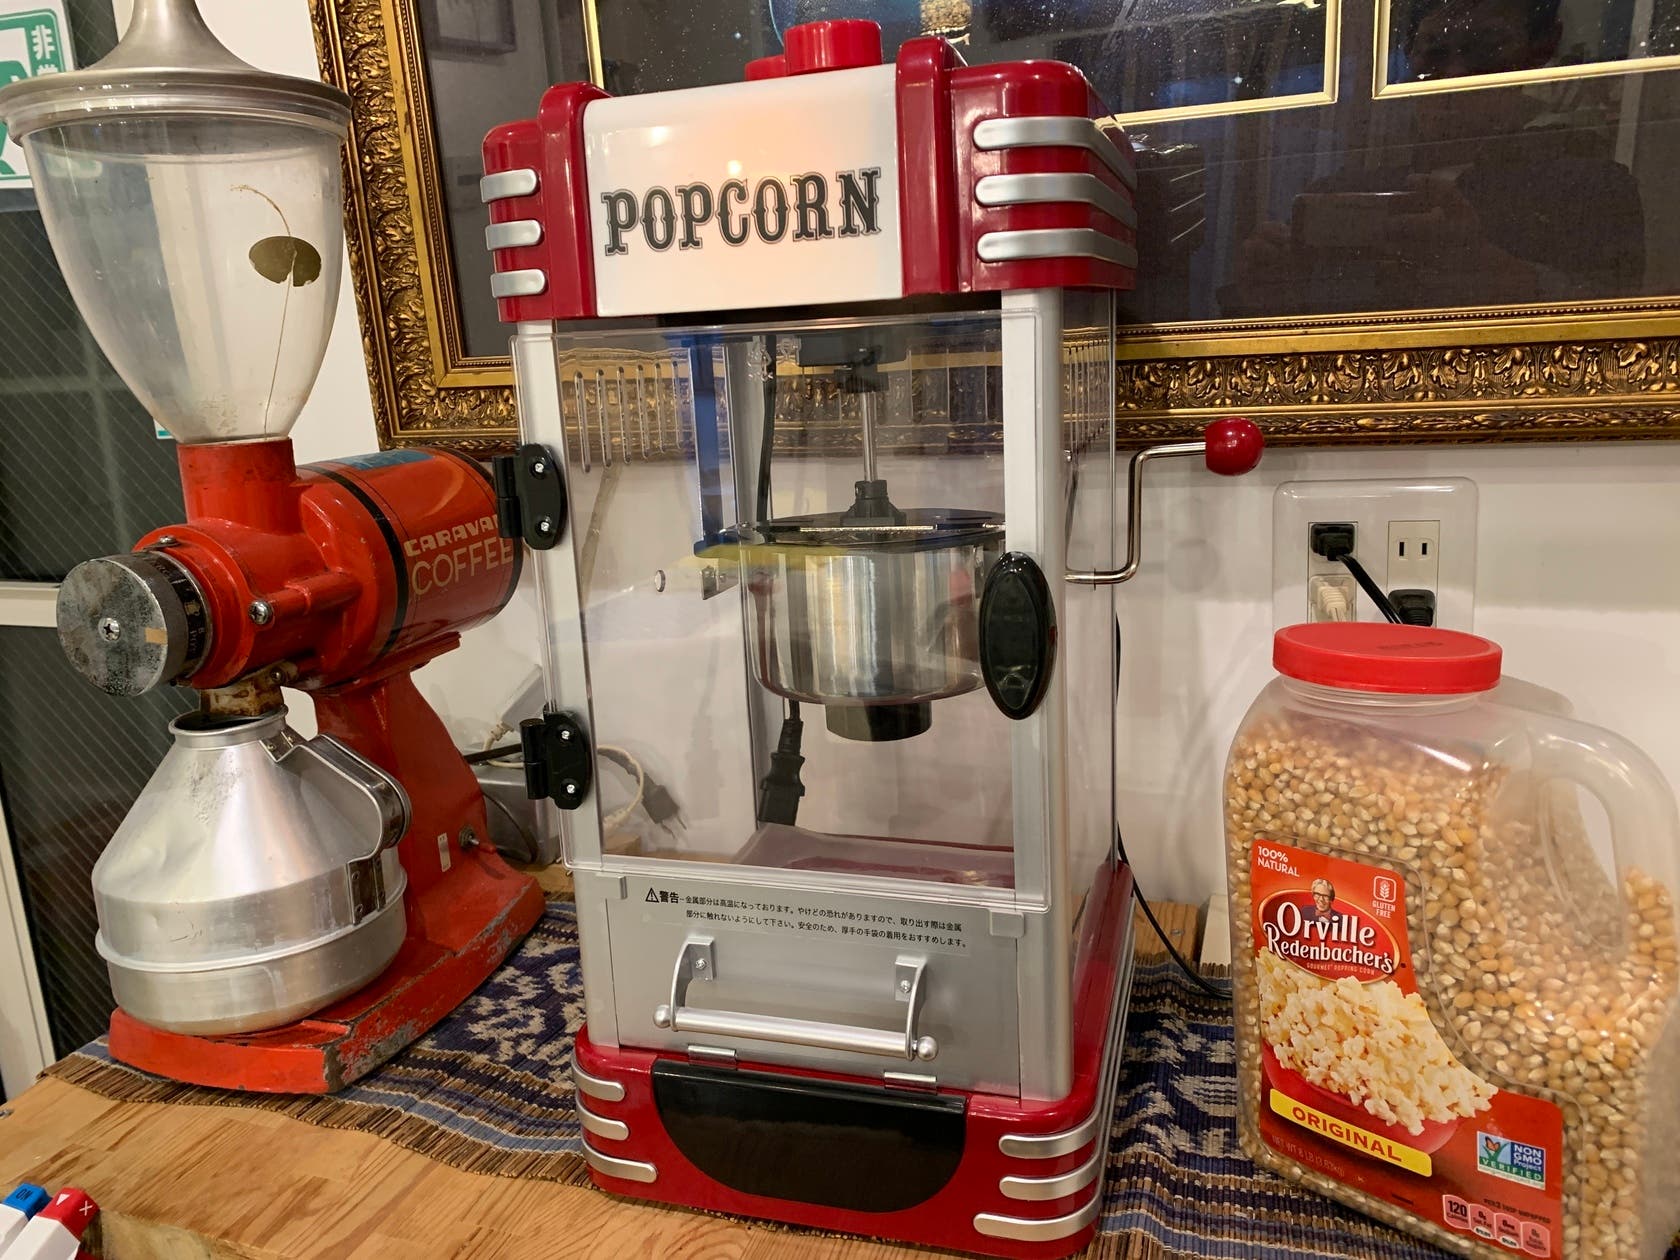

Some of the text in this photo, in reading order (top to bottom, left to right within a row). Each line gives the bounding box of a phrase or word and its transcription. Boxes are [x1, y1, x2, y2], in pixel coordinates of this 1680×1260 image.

[600, 166, 882, 256] POPCORN
[411, 536, 515, 596] COFFEE
[1257, 845, 1289, 863] 100%
[1257, 857, 1300, 878] NATURAL
[1371, 900, 1396, 913] GLUTEN
[1375, 907, 1392, 919] FREE
[1276, 901, 1376, 947] Orville
[1262, 921, 1394, 975] Redenbacher's
[1291, 1106, 1403, 1163] ORIGINAL
[1513, 1152, 1542, 1166] GMO
[1514, 1143, 1542, 1158] NON
[1482, 1158, 1542, 1181] VERIFIED
[1513, 1159, 1542, 1172] Project
[1448, 1200, 1468, 1218] 120
